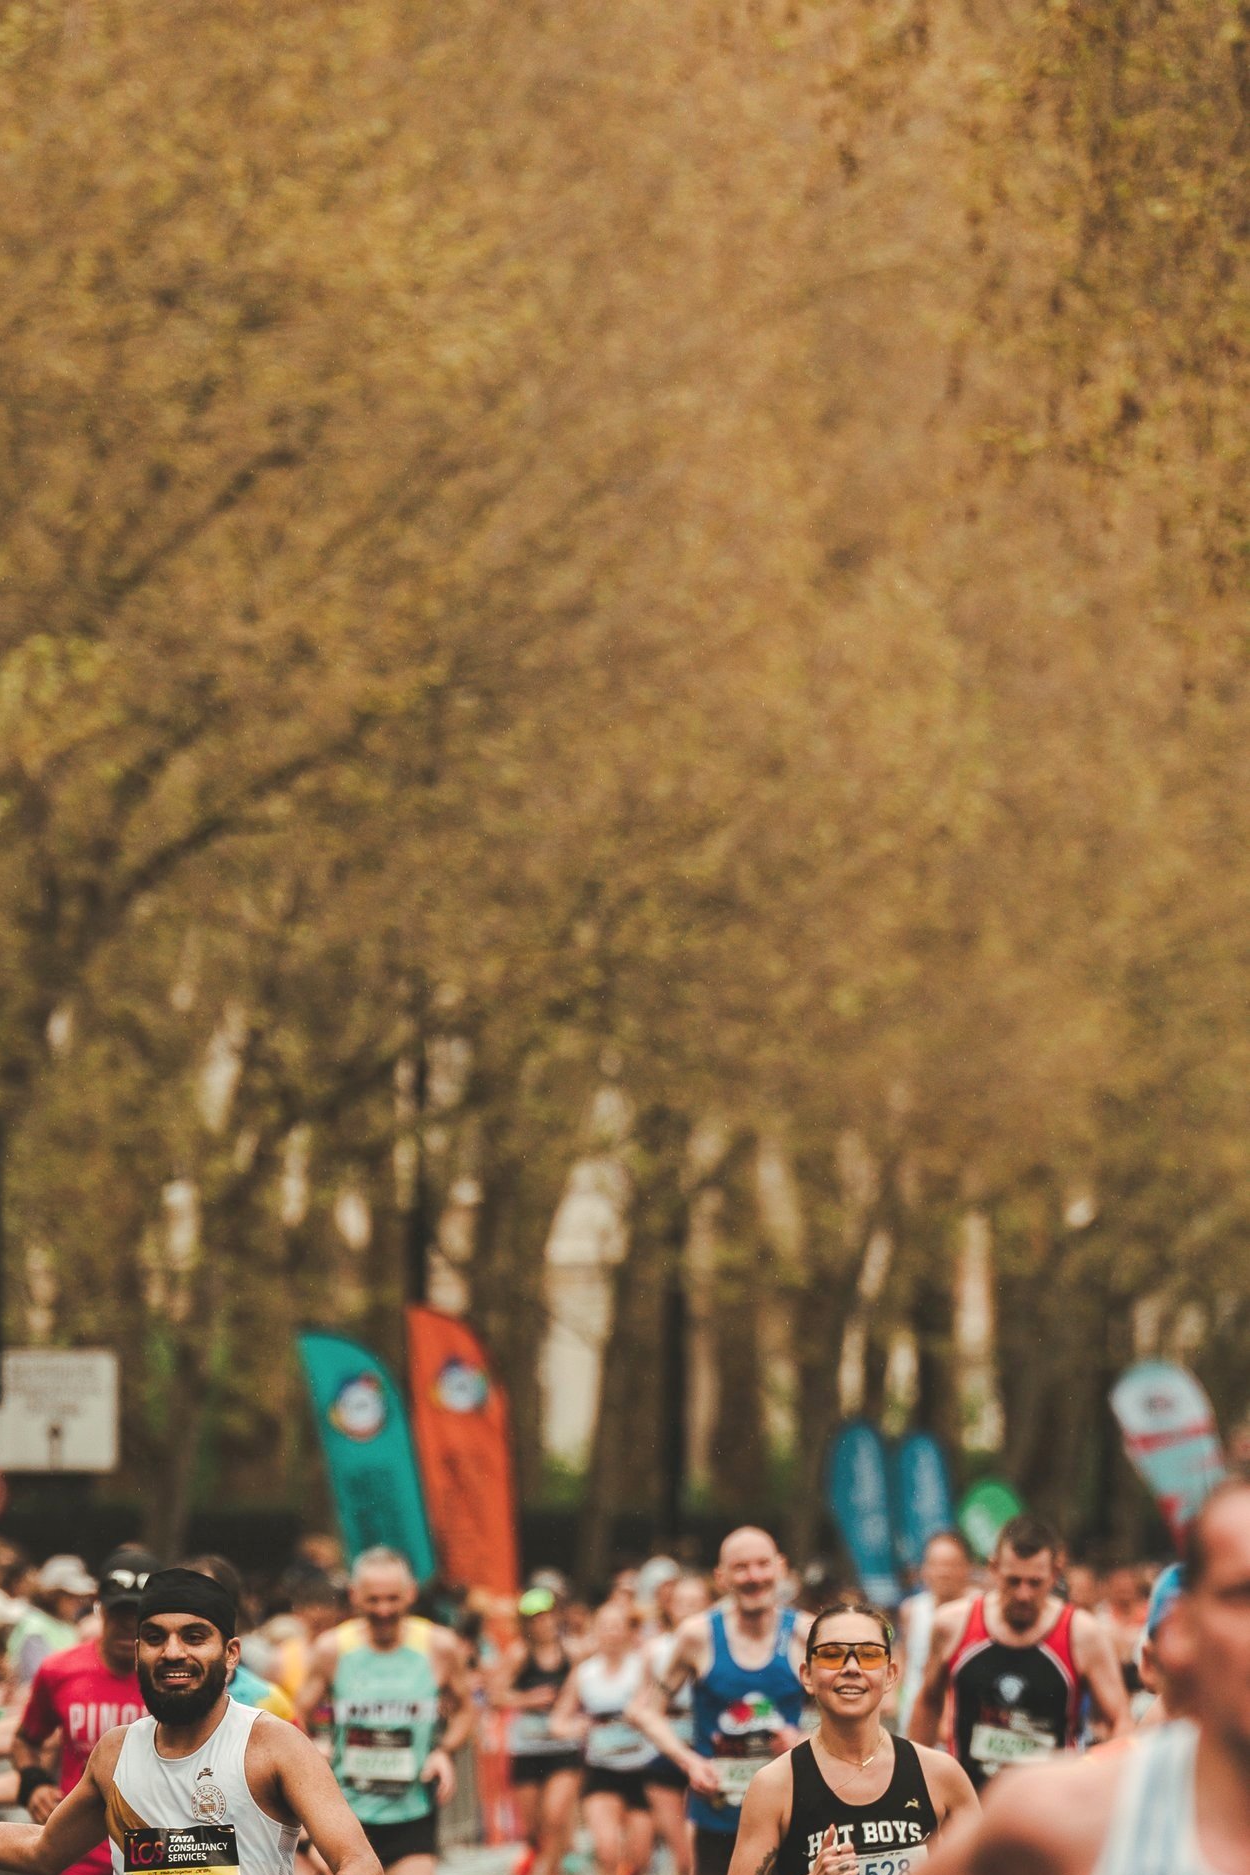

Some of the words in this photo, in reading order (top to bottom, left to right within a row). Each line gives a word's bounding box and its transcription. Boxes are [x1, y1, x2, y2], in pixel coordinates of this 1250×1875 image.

[169, 1835, 196, 1843] TATA
[807, 1824, 854, 1857] HOT
[861, 1820, 922, 1844] BOYS
[168, 1842, 228, 1853] CONSULTANCY
[168, 1852, 207, 1863] SERVICES
